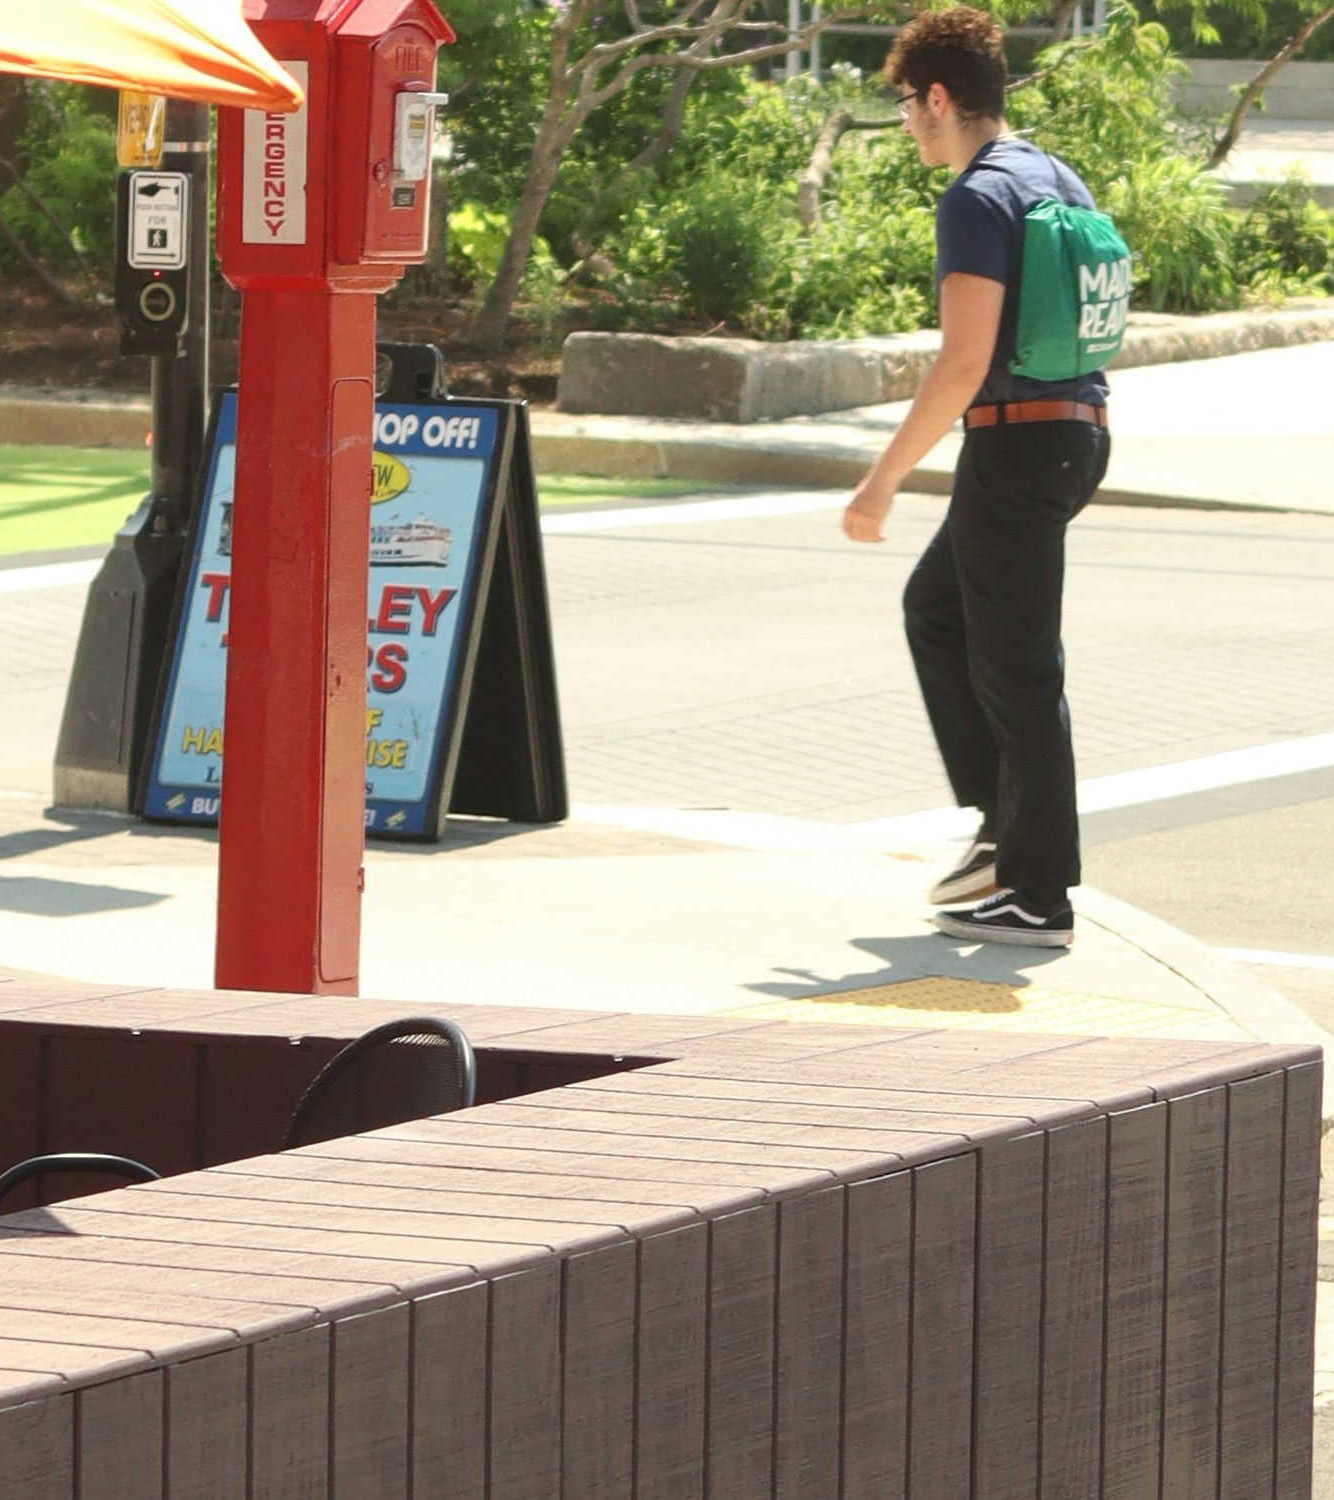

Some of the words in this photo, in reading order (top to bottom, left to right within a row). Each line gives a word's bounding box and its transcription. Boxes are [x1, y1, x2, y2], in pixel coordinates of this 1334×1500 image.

[264, 111, 285, 237] ERGENCY
[148, 215, 168, 225] FOR
[1079, 258, 1133, 302] MAD
[422, 415, 480, 449] OFF!
[191, 797, 220, 815] BU
